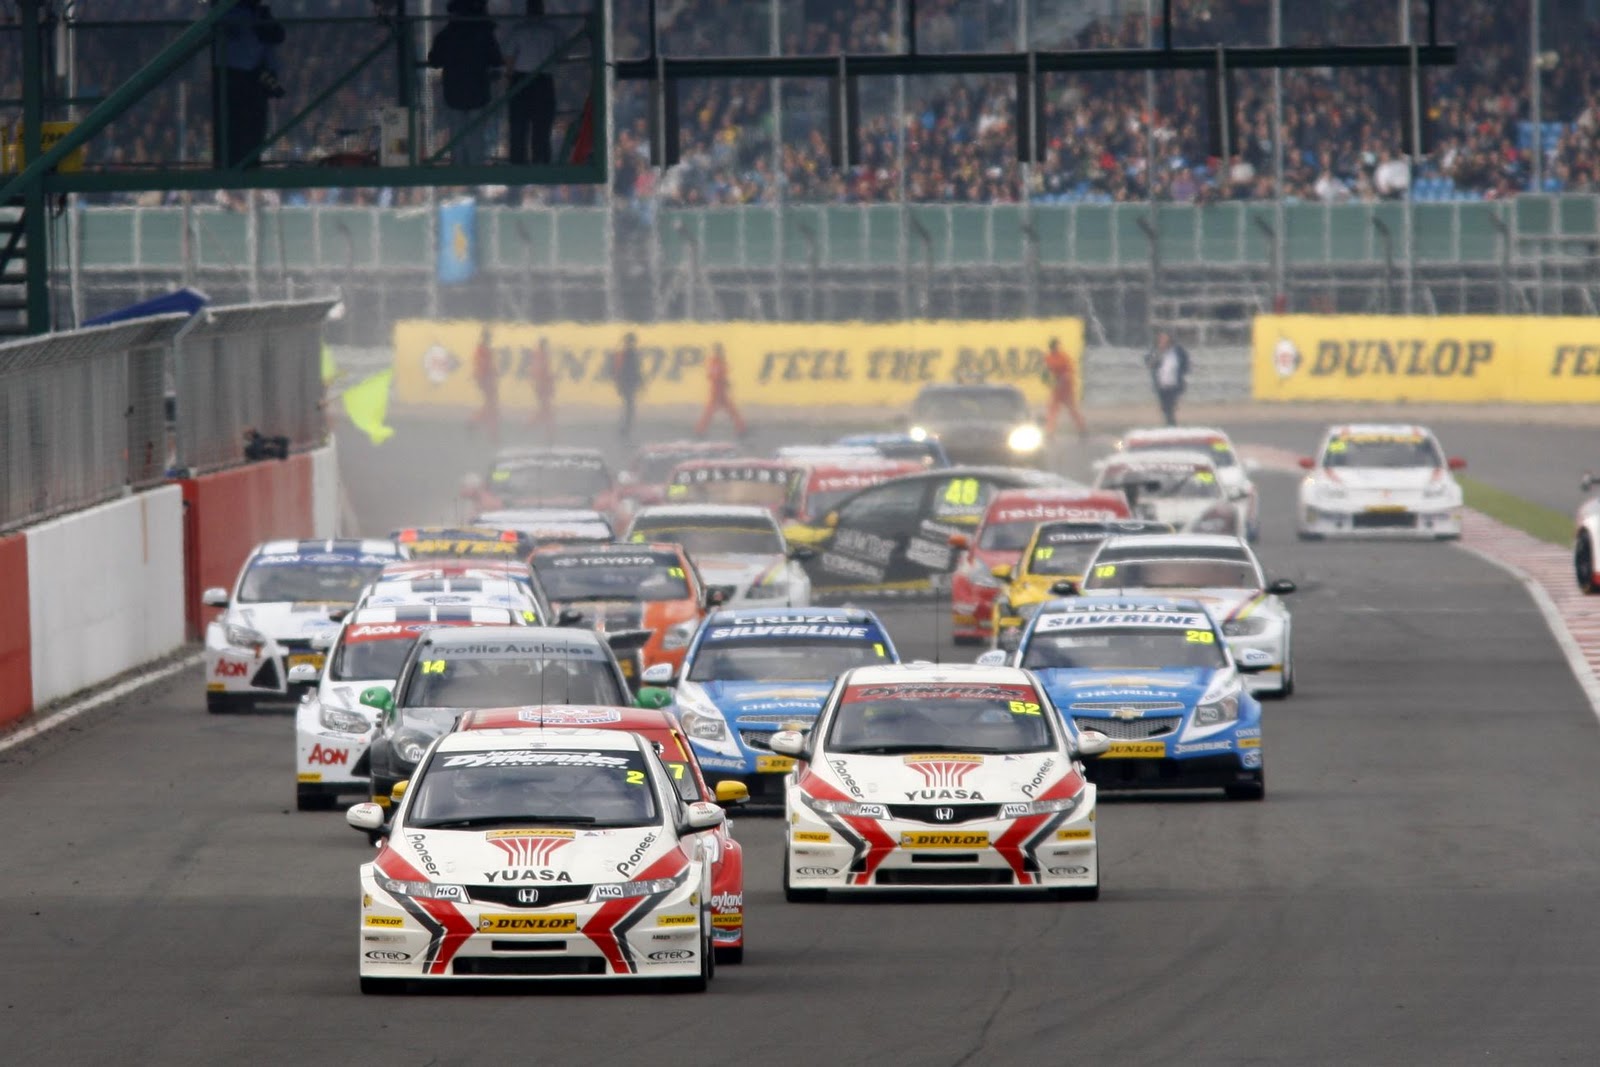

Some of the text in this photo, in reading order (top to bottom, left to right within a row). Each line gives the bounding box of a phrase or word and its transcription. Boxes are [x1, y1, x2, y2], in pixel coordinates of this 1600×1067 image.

[757, 347, 850, 383] FEEL
[866, 347, 942, 380] THE
[1309, 339, 1495, 378] DUNLOP
[1550, 344, 1600, 376] FE
[581, 556, 655, 566] TOYOTA
[734, 615, 849, 625] CRUZE
[351, 625, 402, 638] AON
[1185, 630, 1214, 645] 20
[433, 644, 501, 655] Profile
[872, 643, 885, 656] 1
[214, 657, 248, 677] AON
[422, 660, 446, 675] 14
[1076, 689, 1178, 699] CHEVROLET
[742, 701, 821, 712] CHEVROL
[1009, 700, 1041, 716] 52
[308, 743, 349, 766] AON
[626, 770, 645, 785] 2
[668, 764, 685, 780] 7
[830, 758, 864, 799] Pioneer
[1021, 758, 1055, 799] Pioneer
[905, 789, 985, 801] YUASA
[860, 805, 880, 815] HiQ
[1007, 804, 1028, 814] HiQ
[499, 829, 576, 837] DUNLOP
[917, 836, 987, 845] DUNLOP
[407, 832, 440, 876] Pioneer
[616, 832, 658, 878] Pioneer
[484, 869, 573, 883] YUASA
[804, 867, 829, 875] CTEK
[436, 885, 458, 896] HiQ
[599, 885, 622, 897] HiQ
[711, 891, 743, 911] eyland
[496, 917, 576, 929] DUNLOP
[665, 916, 696, 924] DUNLOP
[373, 951, 400, 960] CTEK
[656, 951, 684, 960] CTEK
